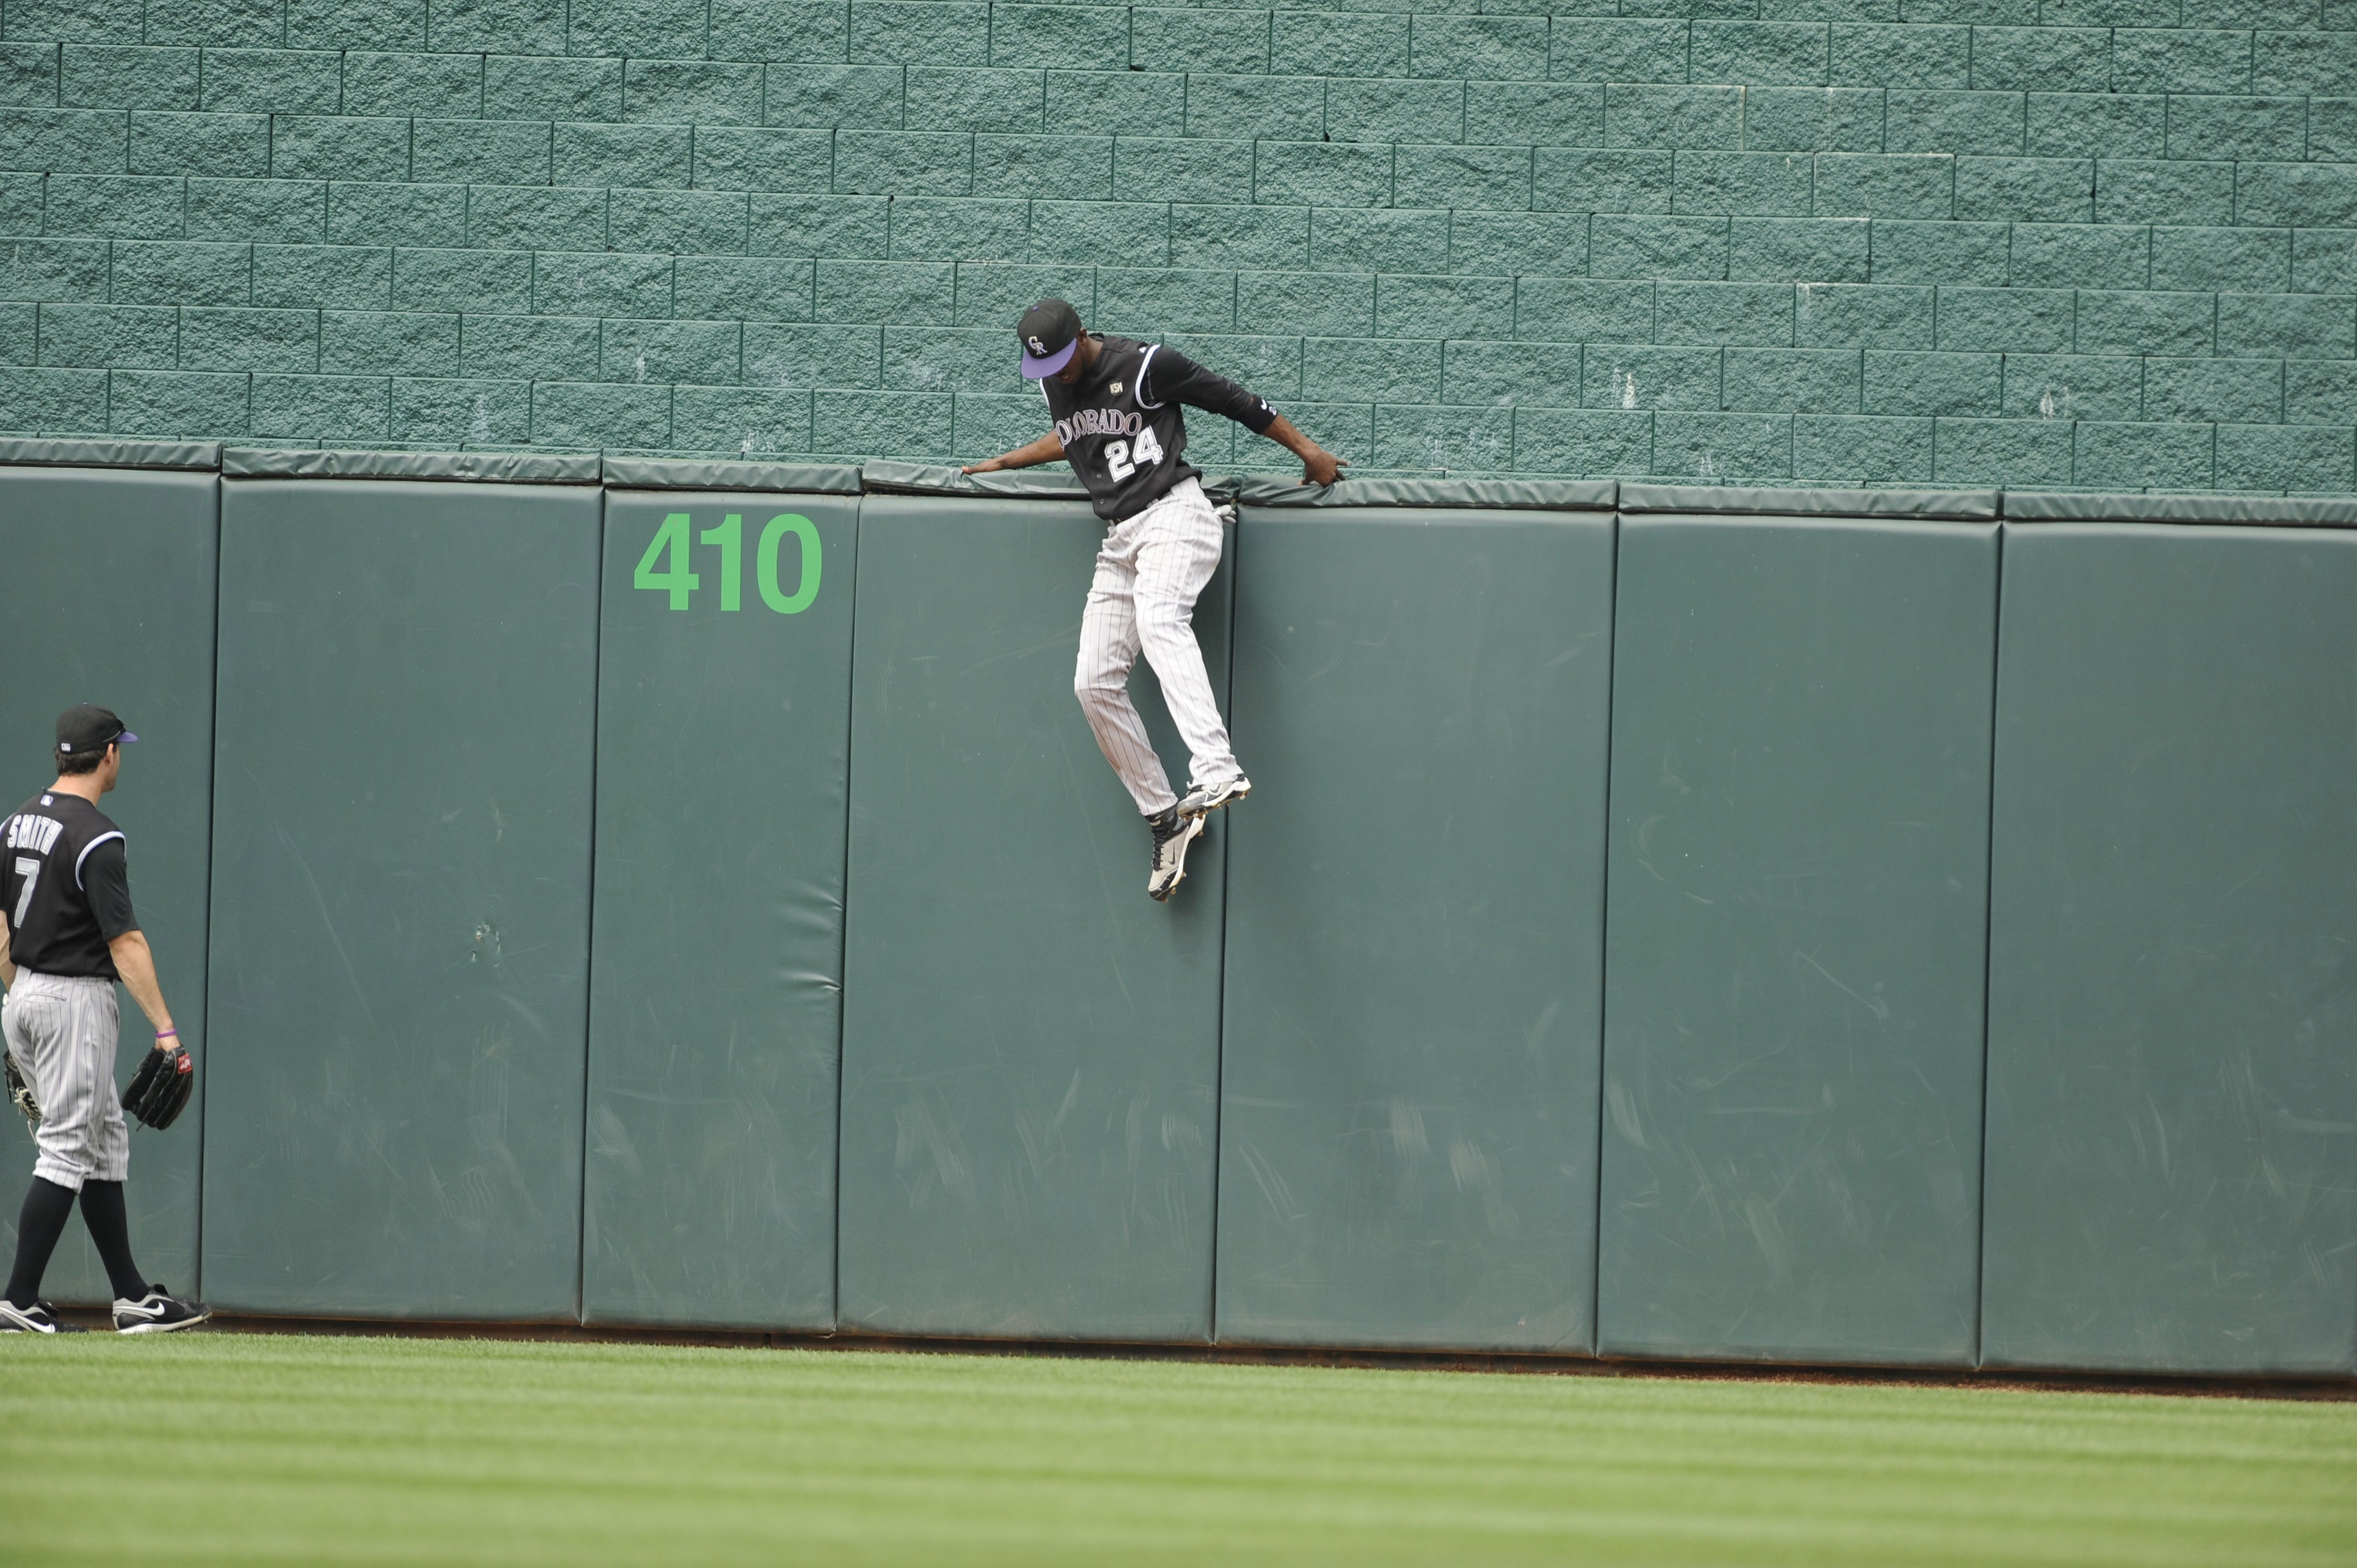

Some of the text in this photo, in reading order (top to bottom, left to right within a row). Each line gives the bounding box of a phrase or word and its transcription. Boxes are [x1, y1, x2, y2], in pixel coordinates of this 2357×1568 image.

[1055, 409, 1142, 451] OLORADO
[1104, 425, 1163, 483] 24
[634, 513, 822, 614] 410
[7, 814, 63, 856] SMITH
[14, 857, 40, 928] 7
